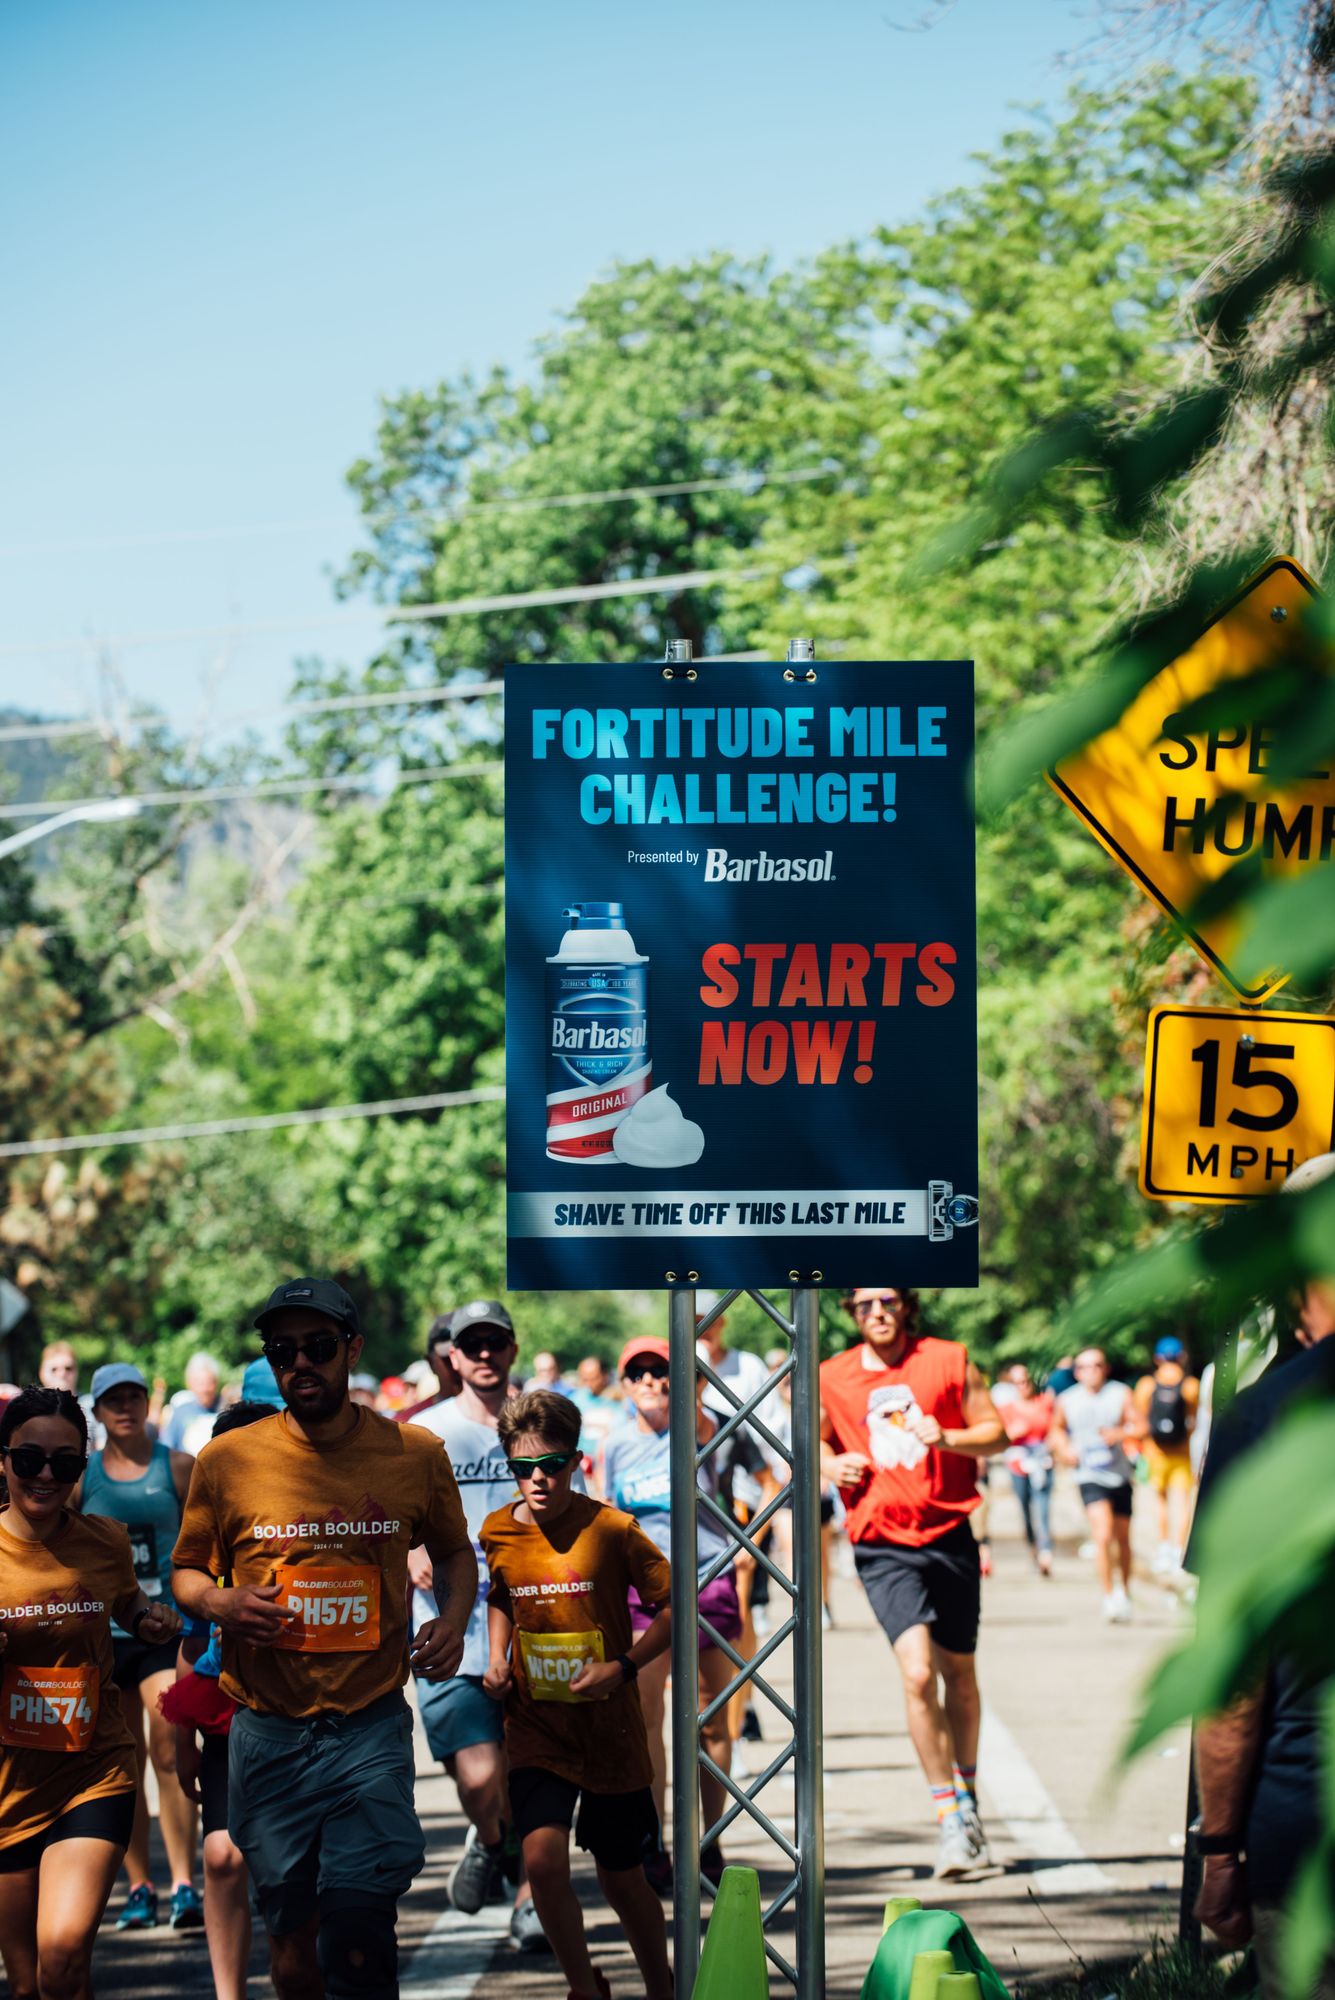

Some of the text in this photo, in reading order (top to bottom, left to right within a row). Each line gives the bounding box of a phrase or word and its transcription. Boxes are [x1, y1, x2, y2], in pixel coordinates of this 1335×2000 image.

[532, 706, 947, 759] FORTITUDE MILE
[1159, 712, 1329, 779] SPE
[580, 773, 897, 825] CHALLENGE!
[628, 848, 833, 882] Presented by Barbasol
[700, 942, 957, 1008] STARTS
[552, 1018, 647, 1049] Barbasol
[576, 1060, 595, 1068] THICK
[607, 1060, 623, 1068] RICH
[698, 1020, 876, 1085] NOW!
[1192, 1039, 1299, 1132] 15
[572, 1093, 628, 1117] ORIGINAL
[1187, 1142, 1294, 1181] MPH
[554, 1201, 905, 1226] SHAVE TIME OFF THIS LAST MILE
[254, 1520, 400, 1539] BOLDER BOULDER
[541, 1581, 594, 1594] BOULDER
[47, 1601, 104, 1614] BOULDER
[287, 1594, 368, 1625] PH575
[527, 1655, 594, 1682] WC02
[10, 1694, 91, 1725] PH574
